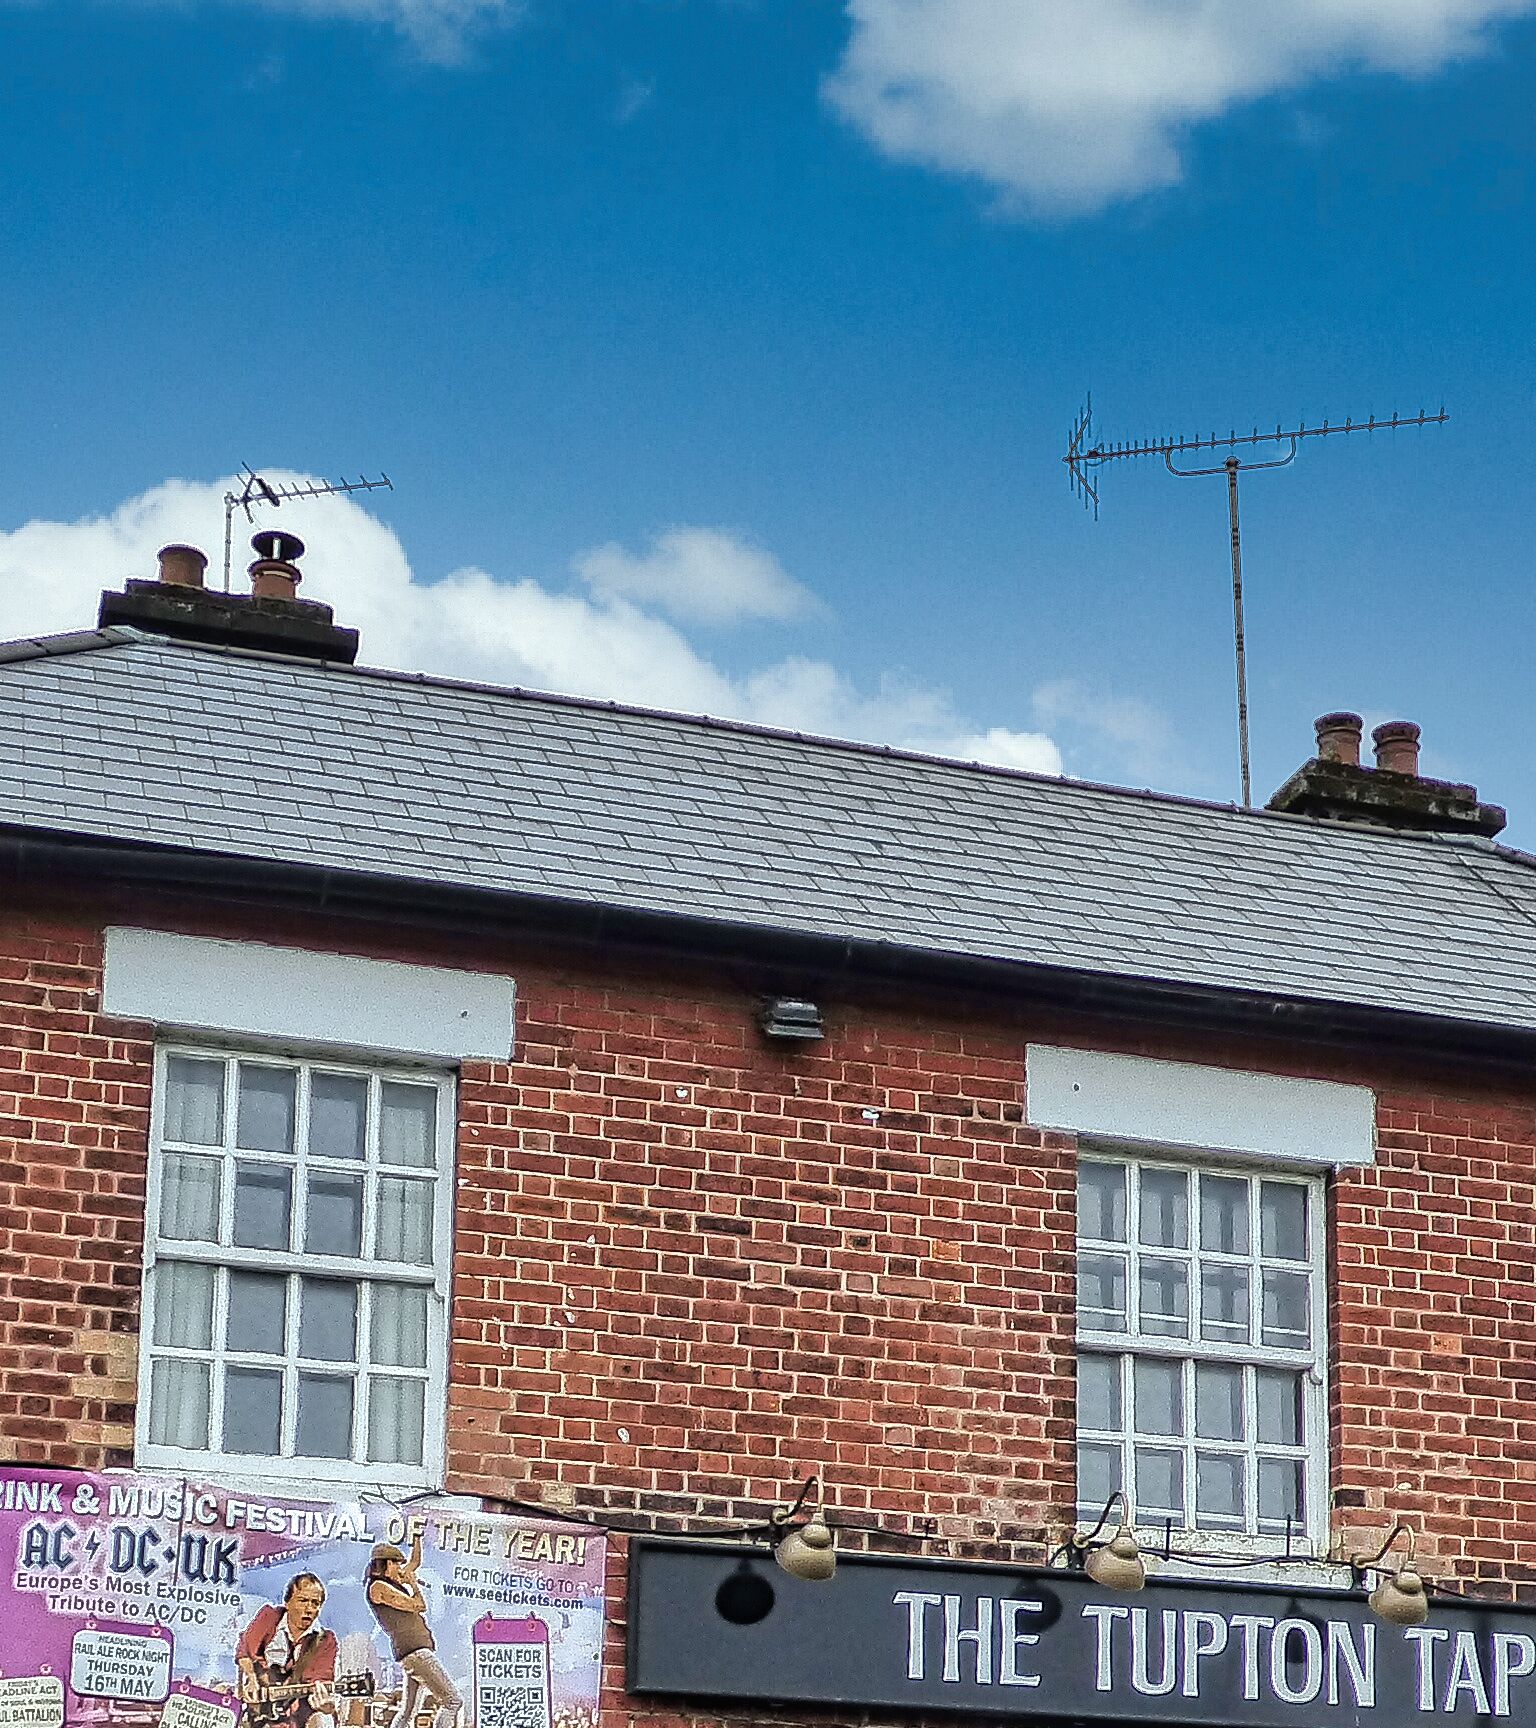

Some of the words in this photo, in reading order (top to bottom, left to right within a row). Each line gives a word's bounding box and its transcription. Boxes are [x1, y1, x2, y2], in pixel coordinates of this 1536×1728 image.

[72, 1483, 101, 1514] &
[108, 1485, 219, 1525] MUSIC
[225, 1499, 376, 1543] FESTIVAL
[385, 1513, 428, 1548] OF
[435, 1520, 493, 1556] THE
[504, 1529, 587, 1566] YEAR!
[22, 1522, 76, 1571] AC
[16, 1573, 99, 1592] Europe's
[105, 1576, 151, 1597] Most
[156, 1584, 241, 1607] Explosive
[454, 1566, 478, 1583] FOR
[482, 1570, 533, 1590] TICKETS
[536, 1577, 555, 1592] GO
[559, 1579, 576, 1594] TO
[442, 1583, 584, 1610] www.seetickets.com
[49, 1595, 116, 1613] Tribute
[122, 1599, 140, 1616] to
[144, 1602, 208, 1625] AC/DC
[75, 1642, 96, 1656] RAIL
[97, 1644, 114, 1658] ALE
[115, 1647, 141, 1661] ROCK
[142, 1650, 170, 1664] NIGHT
[478, 1649, 512, 1663] SCAN
[516, 1649, 542, 1663] FOR
[892, 1590, 1043, 1688] THE
[1081, 1603, 1377, 1708] TUPTON
[87, 1659, 154, 1677] THURSDAY
[479, 1664, 542, 1679] TICKETS
[39, 1686, 58, 1695] ACT
[85, 1674, 117, 1692] 16TH
[119, 1678, 154, 1697] MAY
[12, 1708, 62, 1722] BATTALION
